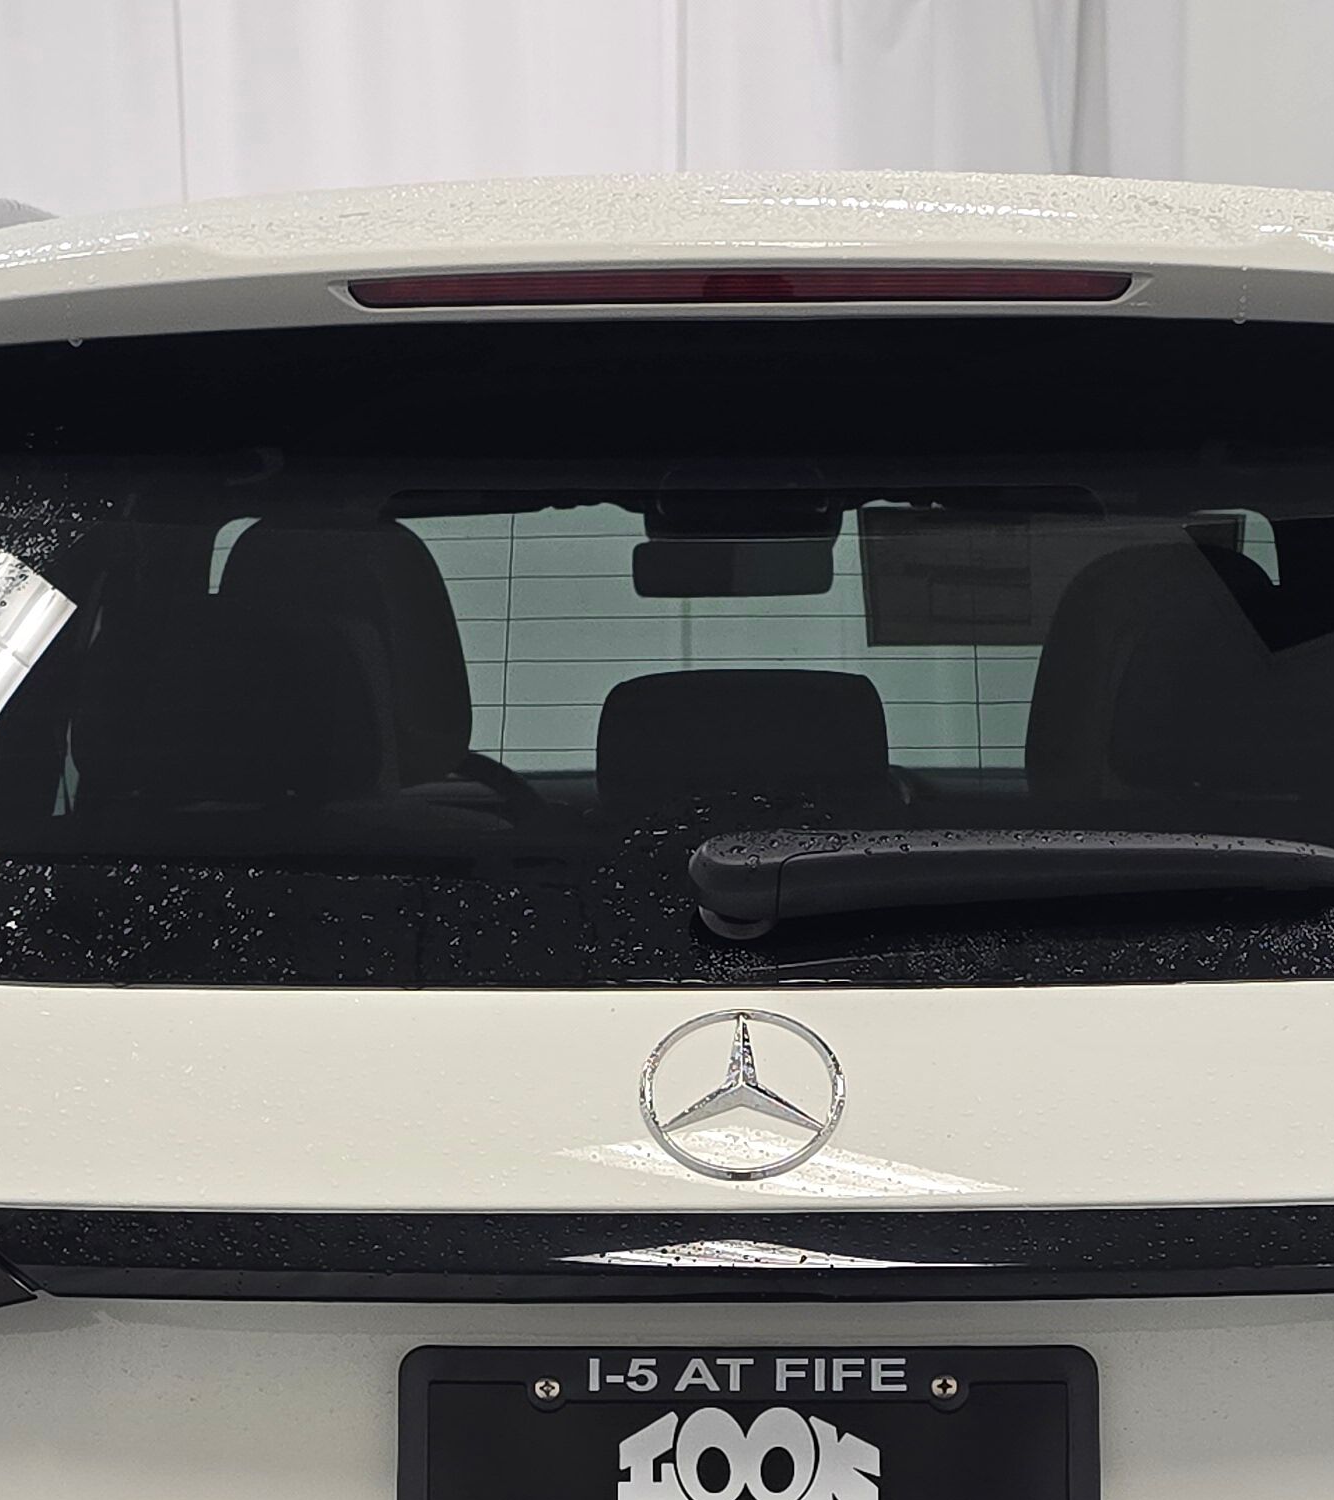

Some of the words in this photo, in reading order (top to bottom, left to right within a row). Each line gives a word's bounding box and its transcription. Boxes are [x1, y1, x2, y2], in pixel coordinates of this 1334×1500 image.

[588, 1358, 658, 1392] I-5
[674, 1358, 755, 1392] AT
[775, 1358, 908, 1392] FIFE
